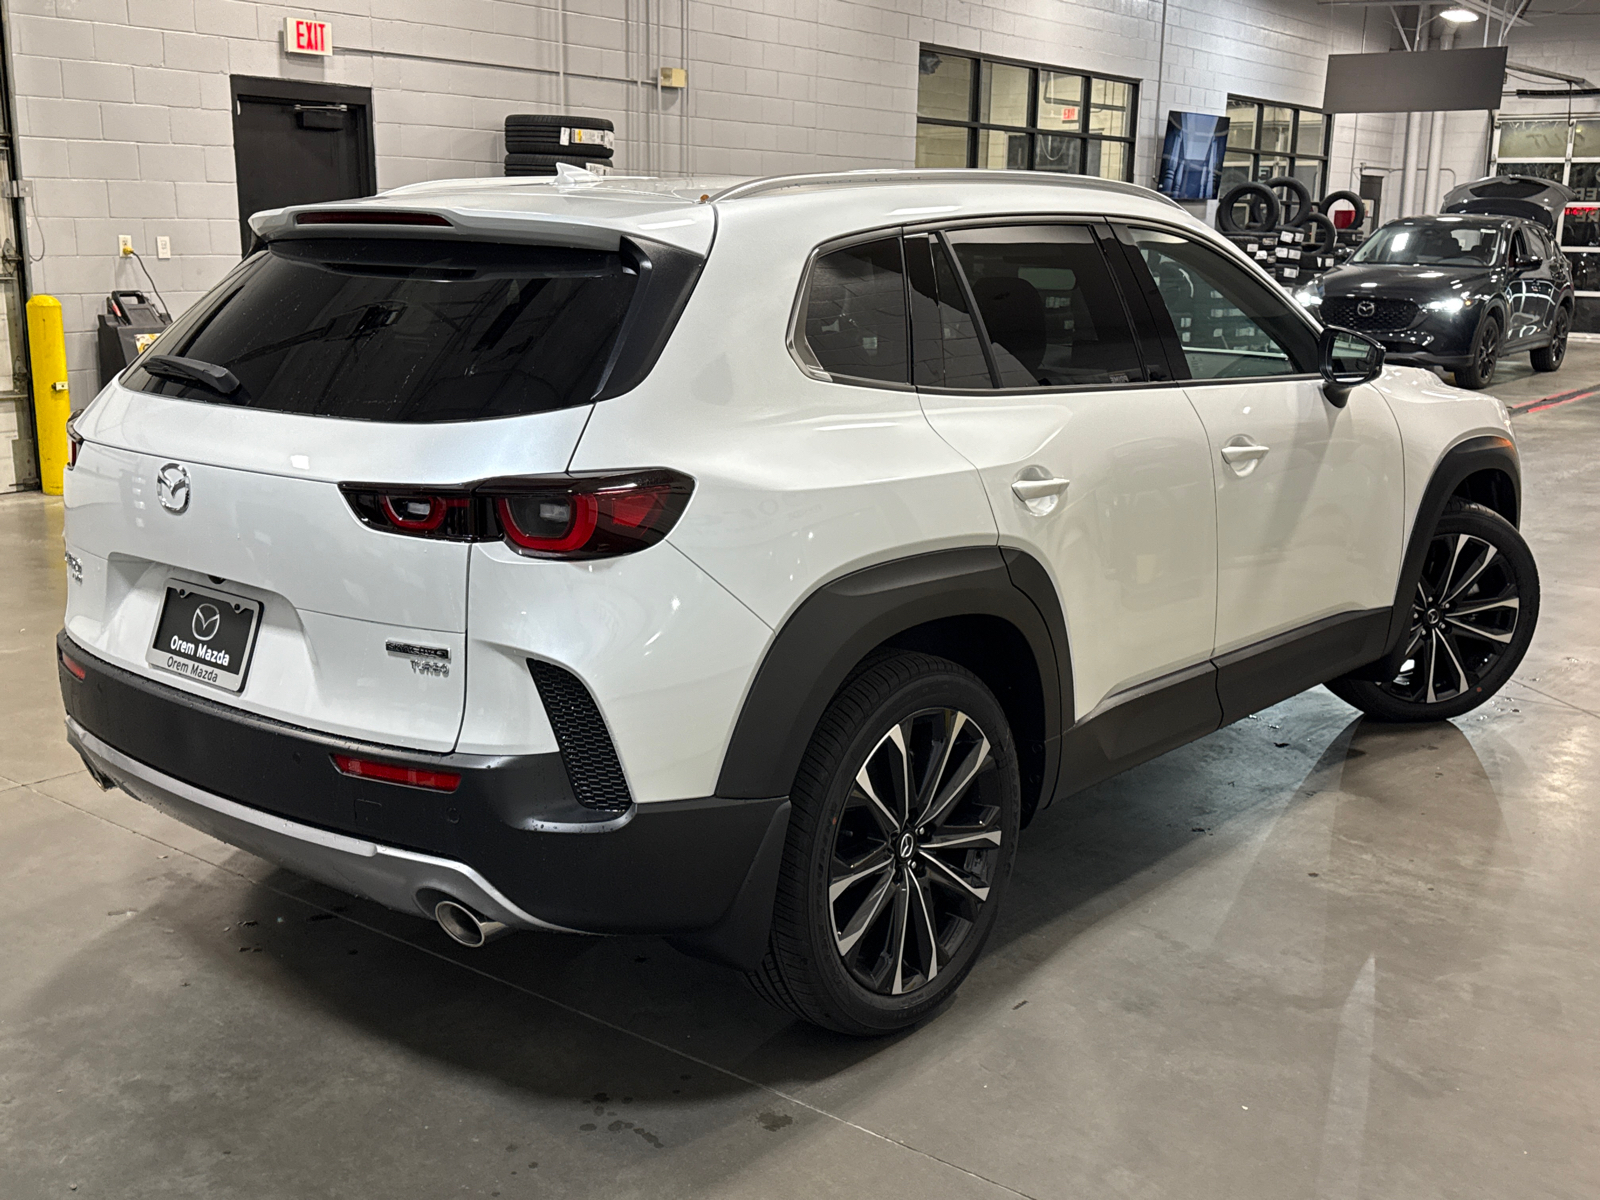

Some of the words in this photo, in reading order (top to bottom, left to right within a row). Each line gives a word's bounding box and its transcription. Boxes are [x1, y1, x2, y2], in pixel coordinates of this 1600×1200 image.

[296, 20, 325, 51] EXIT
[170, 635, 195, 656] Orem
[196, 643, 230, 667] Mazda
[166, 656, 189, 674] Orem
[190, 663, 218, 682] Mazda
